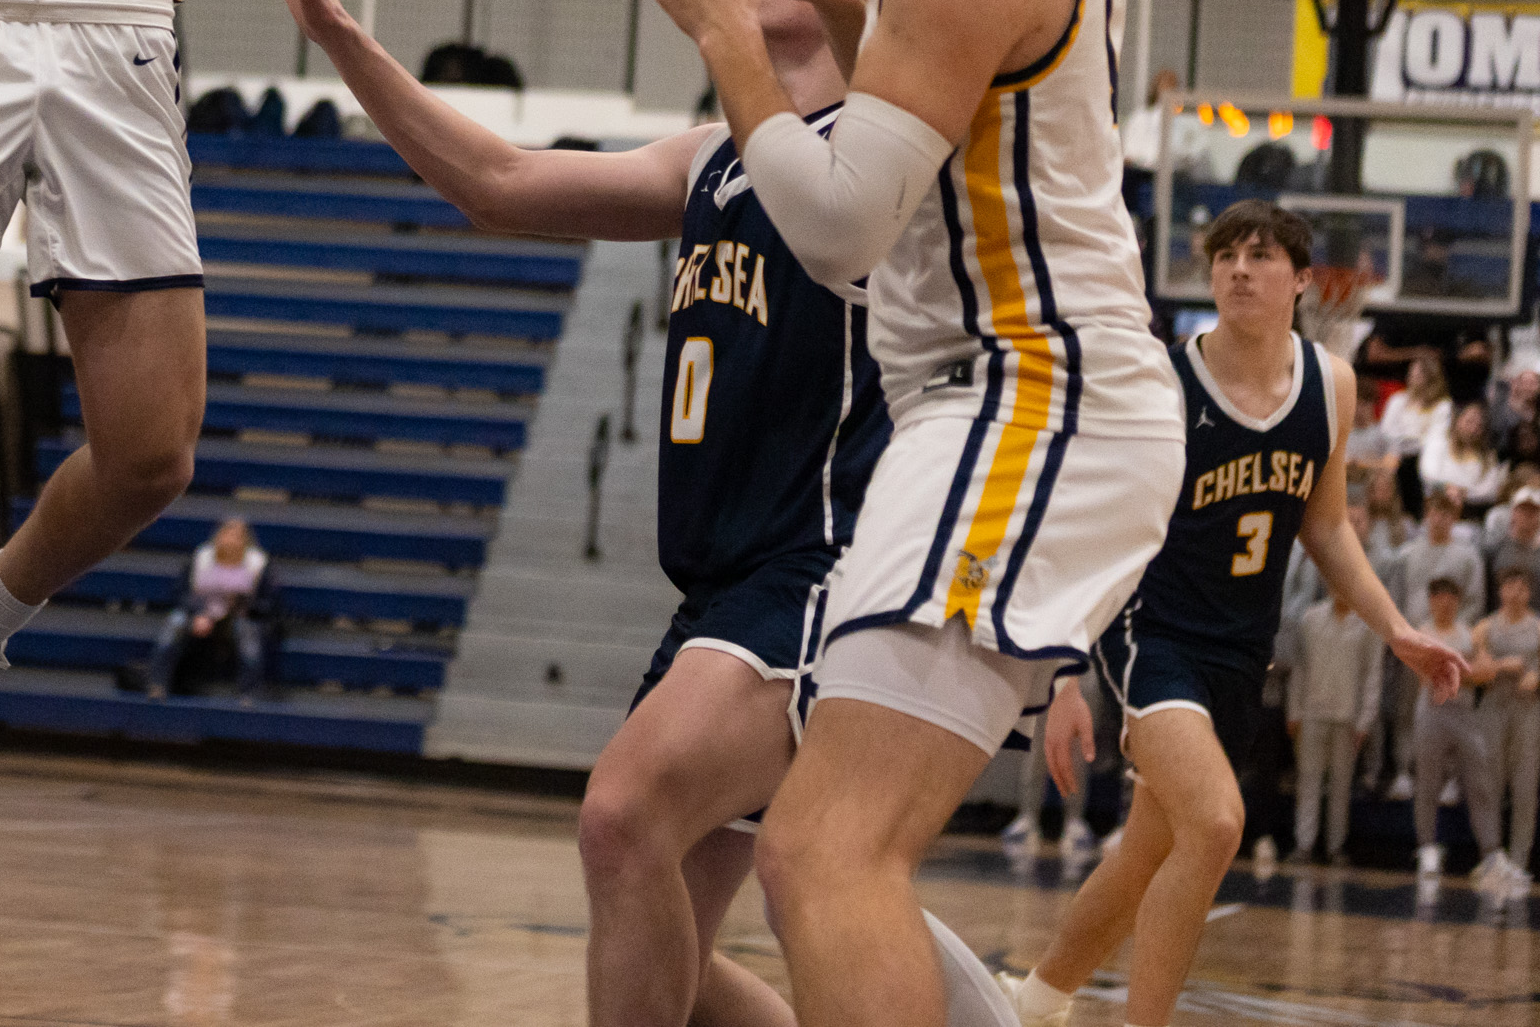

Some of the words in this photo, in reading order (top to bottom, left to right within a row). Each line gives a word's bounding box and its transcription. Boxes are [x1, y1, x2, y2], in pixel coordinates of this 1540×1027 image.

[670, 336, 714, 444] 0
[1192, 449, 1314, 511] CHELSEA
[1230, 511, 1274, 577] 3
